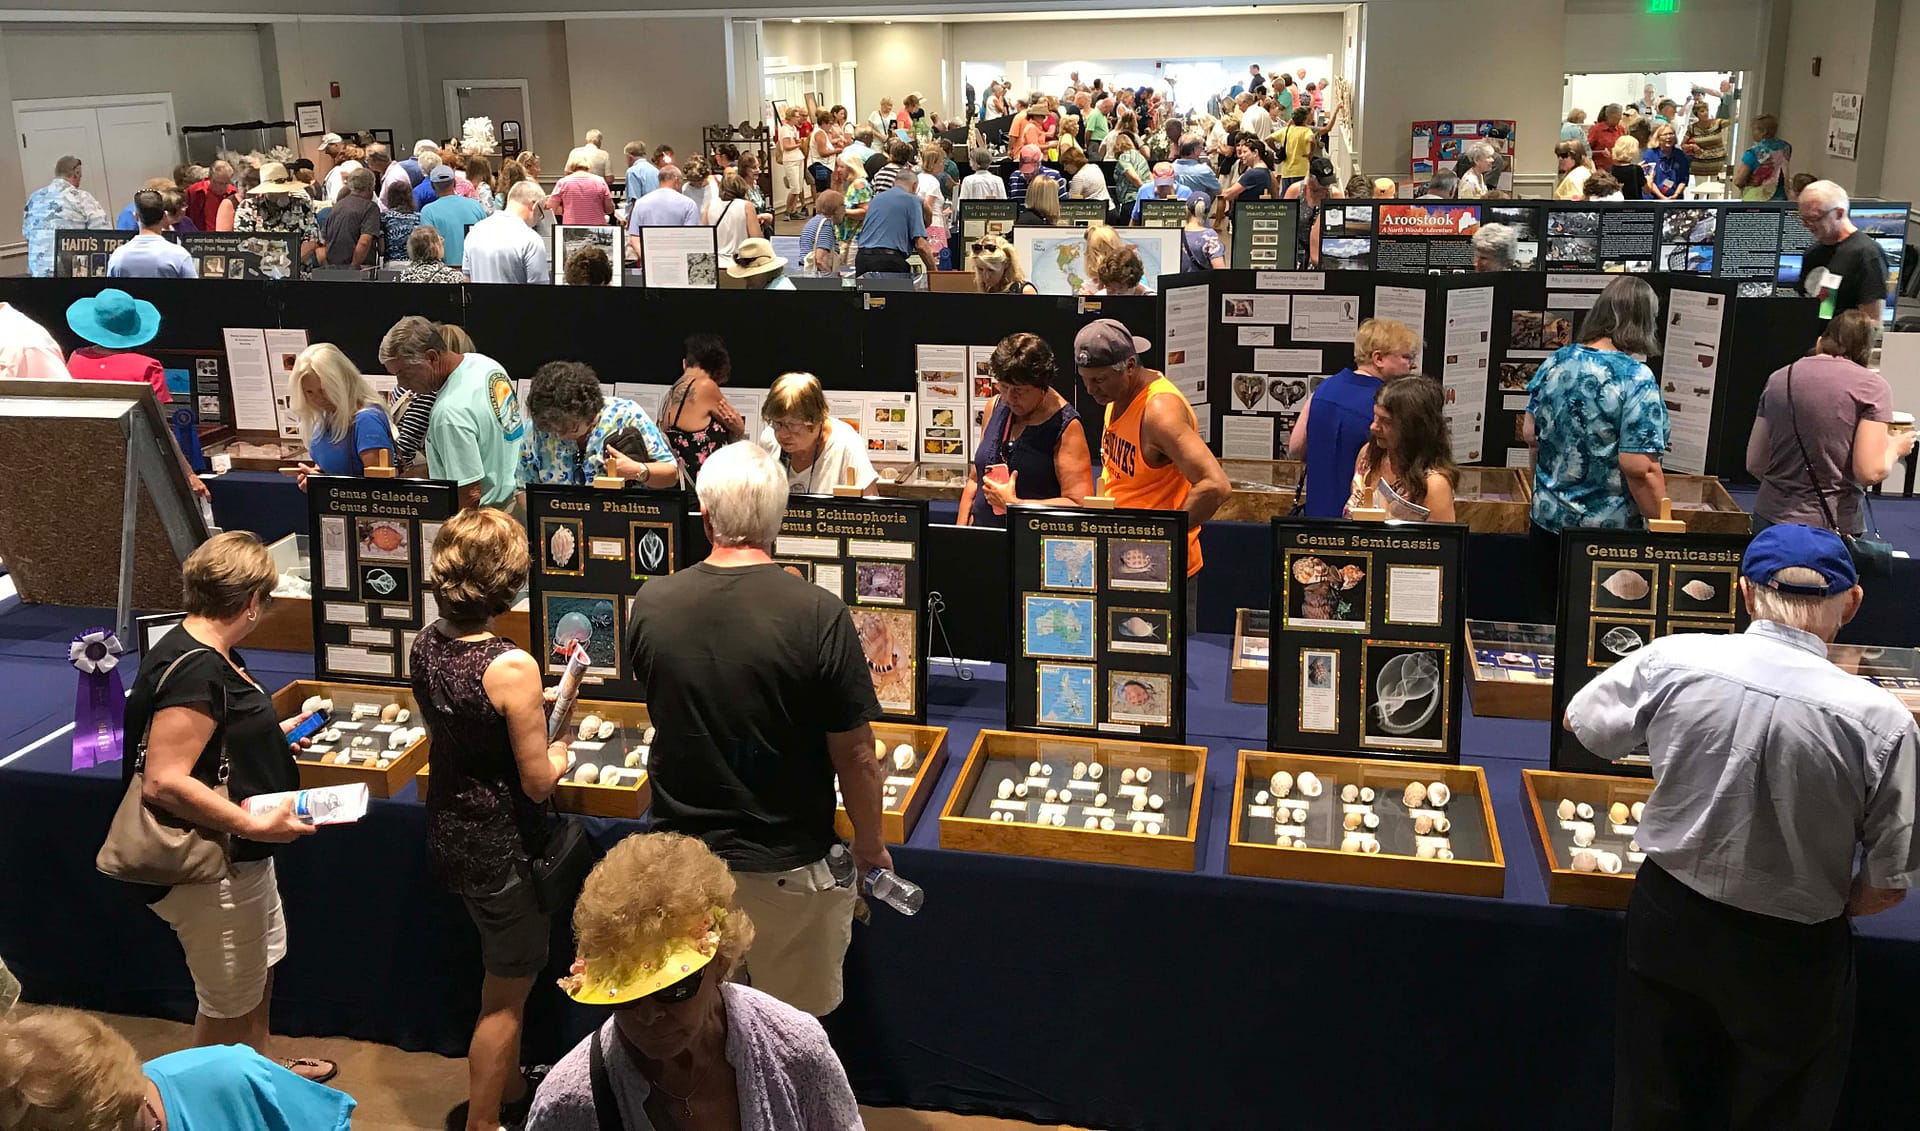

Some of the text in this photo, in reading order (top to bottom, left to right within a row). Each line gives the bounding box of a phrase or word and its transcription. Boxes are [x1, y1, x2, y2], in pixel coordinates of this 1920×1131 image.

[1383, 213, 1454, 226] Aroostook
[61, 237, 98, 251] HAITI'S
[329, 488, 429, 504] Genus Galeodea
[329, 501, 419, 516] Genus Sconsia
[550, 499, 661, 515] Genus Phalium
[782, 507, 908, 524] enus Echinophoria
[781, 521, 885, 537] enus Casmaria
[1028, 518, 1165, 537] Genus Semicassis
[1296, 533, 1441, 550] Genus Semicassis
[1585, 544, 1741, 562] Genus Semicassis
